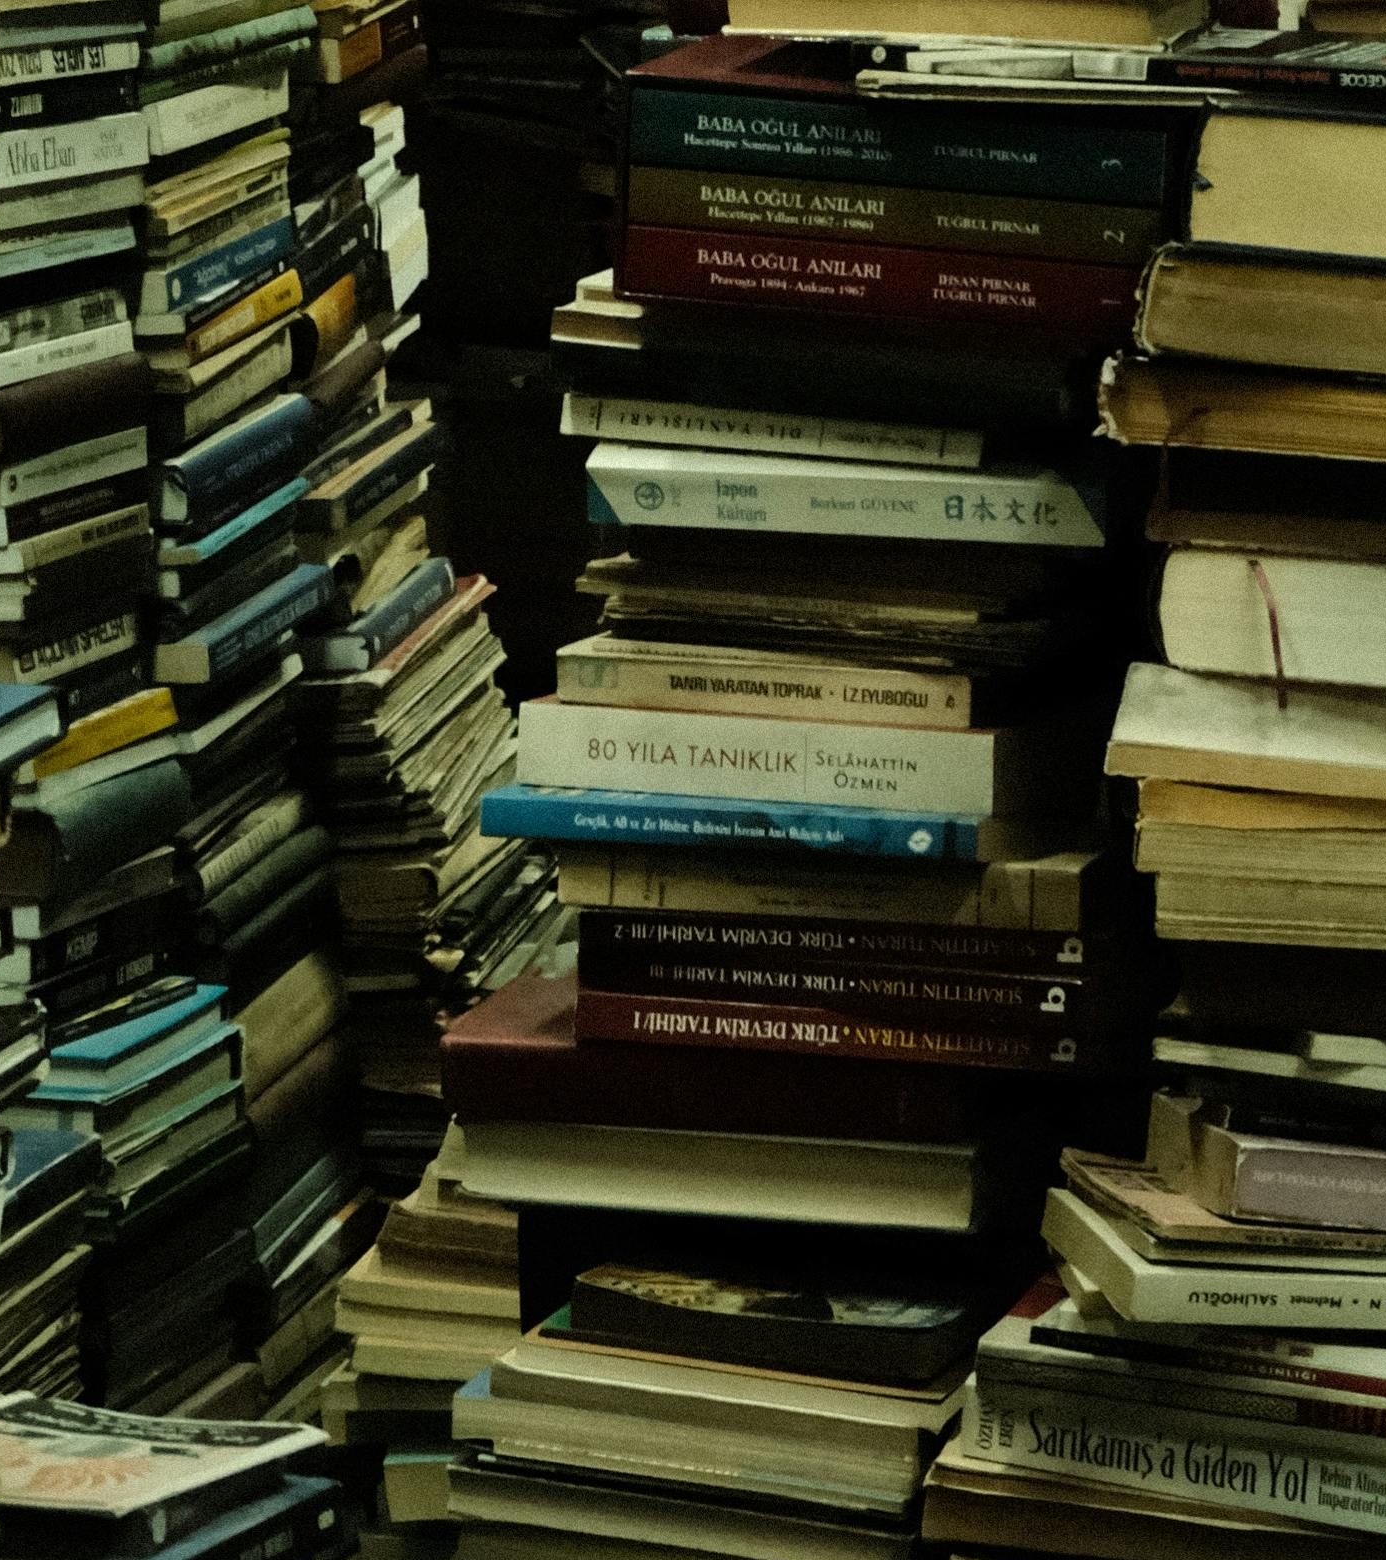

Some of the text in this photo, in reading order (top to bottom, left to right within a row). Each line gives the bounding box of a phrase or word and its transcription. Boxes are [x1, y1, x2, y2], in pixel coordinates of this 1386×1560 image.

[697, 113, 883, 146] BABA OĞUL ANILARI
[701, 185, 886, 218] BABA OĞUL ANILARI
[697, 248, 883, 281] BABA OĞUL ANILARI
[944, 492, 1059, 527] 日本文化
[771, 681, 823, 700] TOPRAK
[587, 737, 799, 774] 80 YILA TANIKLIK
[720, 926, 792, 950] DEVRİM
[796, 931, 844, 953] TÜRK
[714, 1016, 916, 1049] TURAN TÜRK DEVRİM
[1290, 1295, 1343, 1310] Mehmet
[1027, 1407, 1308, 1505] Sarıkamış'a Giden Yol
